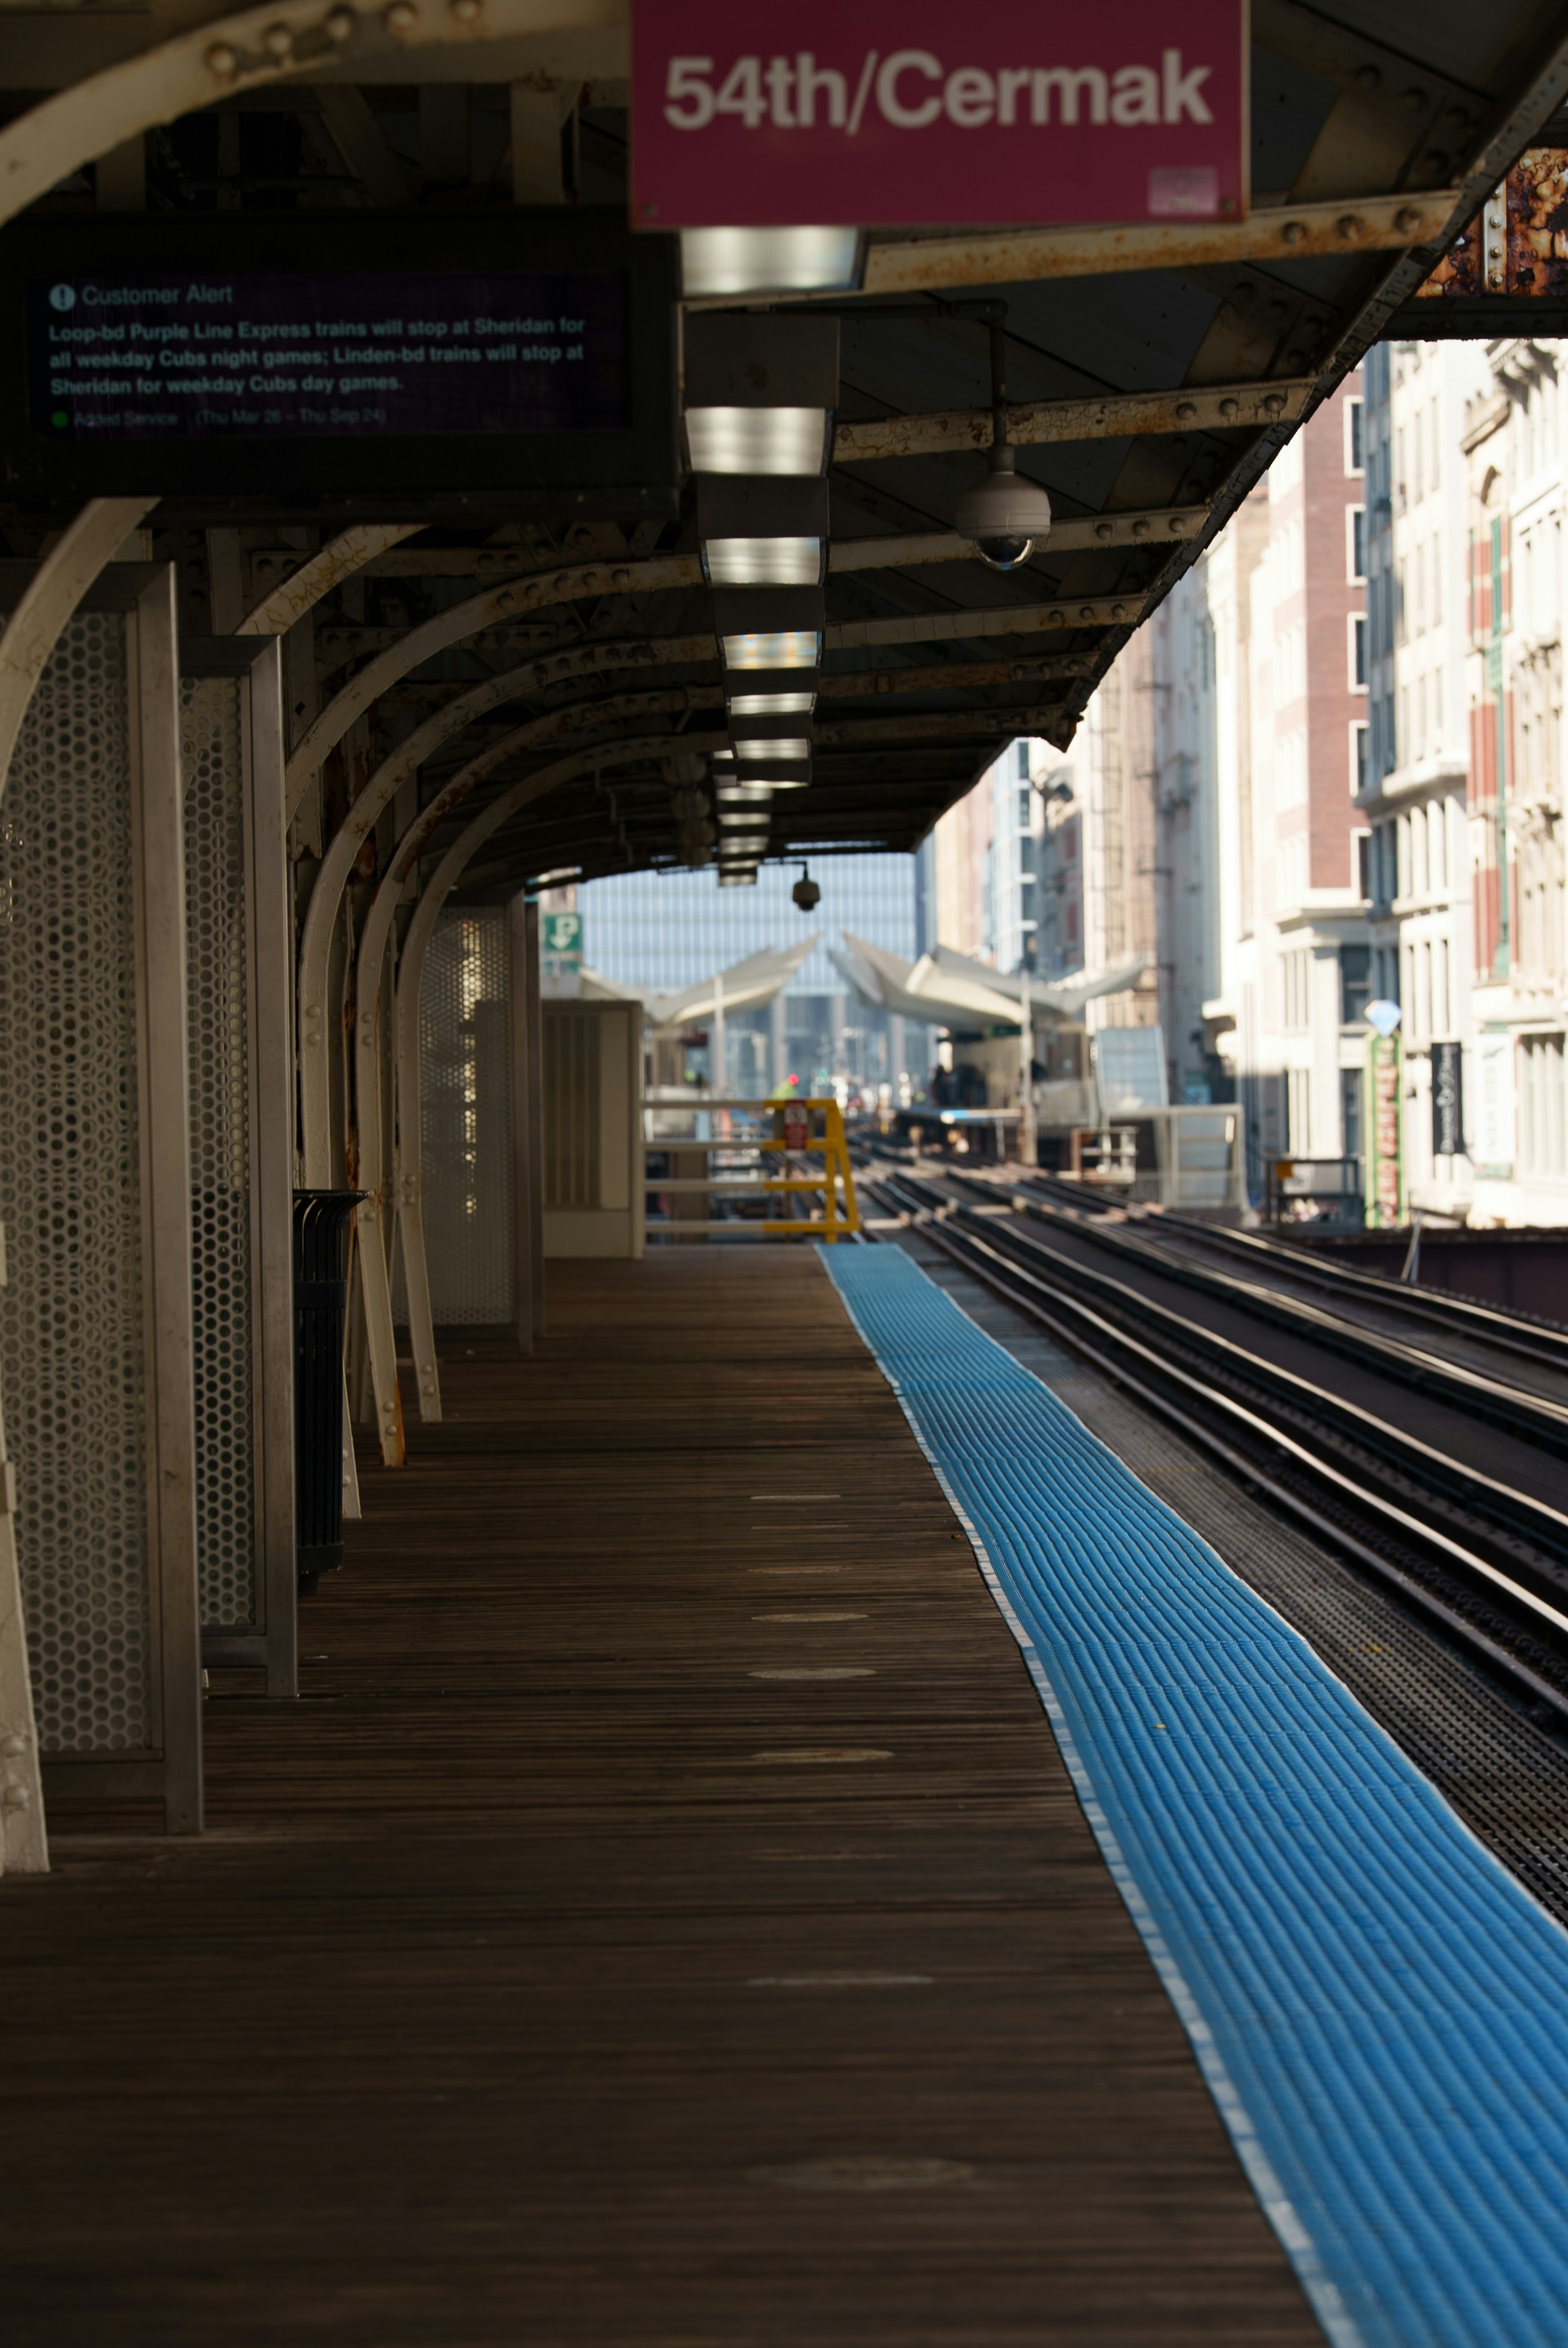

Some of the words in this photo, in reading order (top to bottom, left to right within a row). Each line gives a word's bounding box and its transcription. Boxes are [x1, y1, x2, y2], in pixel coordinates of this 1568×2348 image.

[663, 49, 1213, 136] 54th/Cermak
[82, 285, 181, 305] Customer
[186, 283, 233, 304] Alert
[49, 323, 125, 345] Loop-bd
[130, 323, 189, 344] Purple
[194, 322, 233, 340] Line
[238, 321, 311, 342] Express
[315, 320, 367, 338] trains
[371, 318, 403, 336] will
[407, 318, 448, 339] stop
[452, 319, 470, 335] at
[474, 316, 555, 334] Sheridan
[559, 316, 586, 333] for
[49, 350, 71, 369] all
[75, 350, 155, 371] weekday
[158, 349, 207, 367] Cubs
[211, 348, 258, 370] night
[262, 348, 329, 370] games;
[333, 346, 425, 364] Linden-bd
[429, 345, 482, 362] trains
[485, 344, 518, 361] will
[521, 344, 562, 364] stop
[566, 344, 585, 361] at
[50, 377, 132, 396] Sheridan
[136, 377, 163, 394] for
[166, 376, 245, 396] weekday
[249, 374, 298, 393] Cubs
[301, 374, 335, 395] day
[338, 376, 404, 394] games.
[75, 410, 121, 427] Added
[124, 409, 178, 426] Service
[196, 409, 229, 426] (Thu
[232, 408, 259, 425] Mar
[263, 408, 283, 425] 26
[298, 407, 326, 423] Thu
[330, 408, 359, 425] Sep
